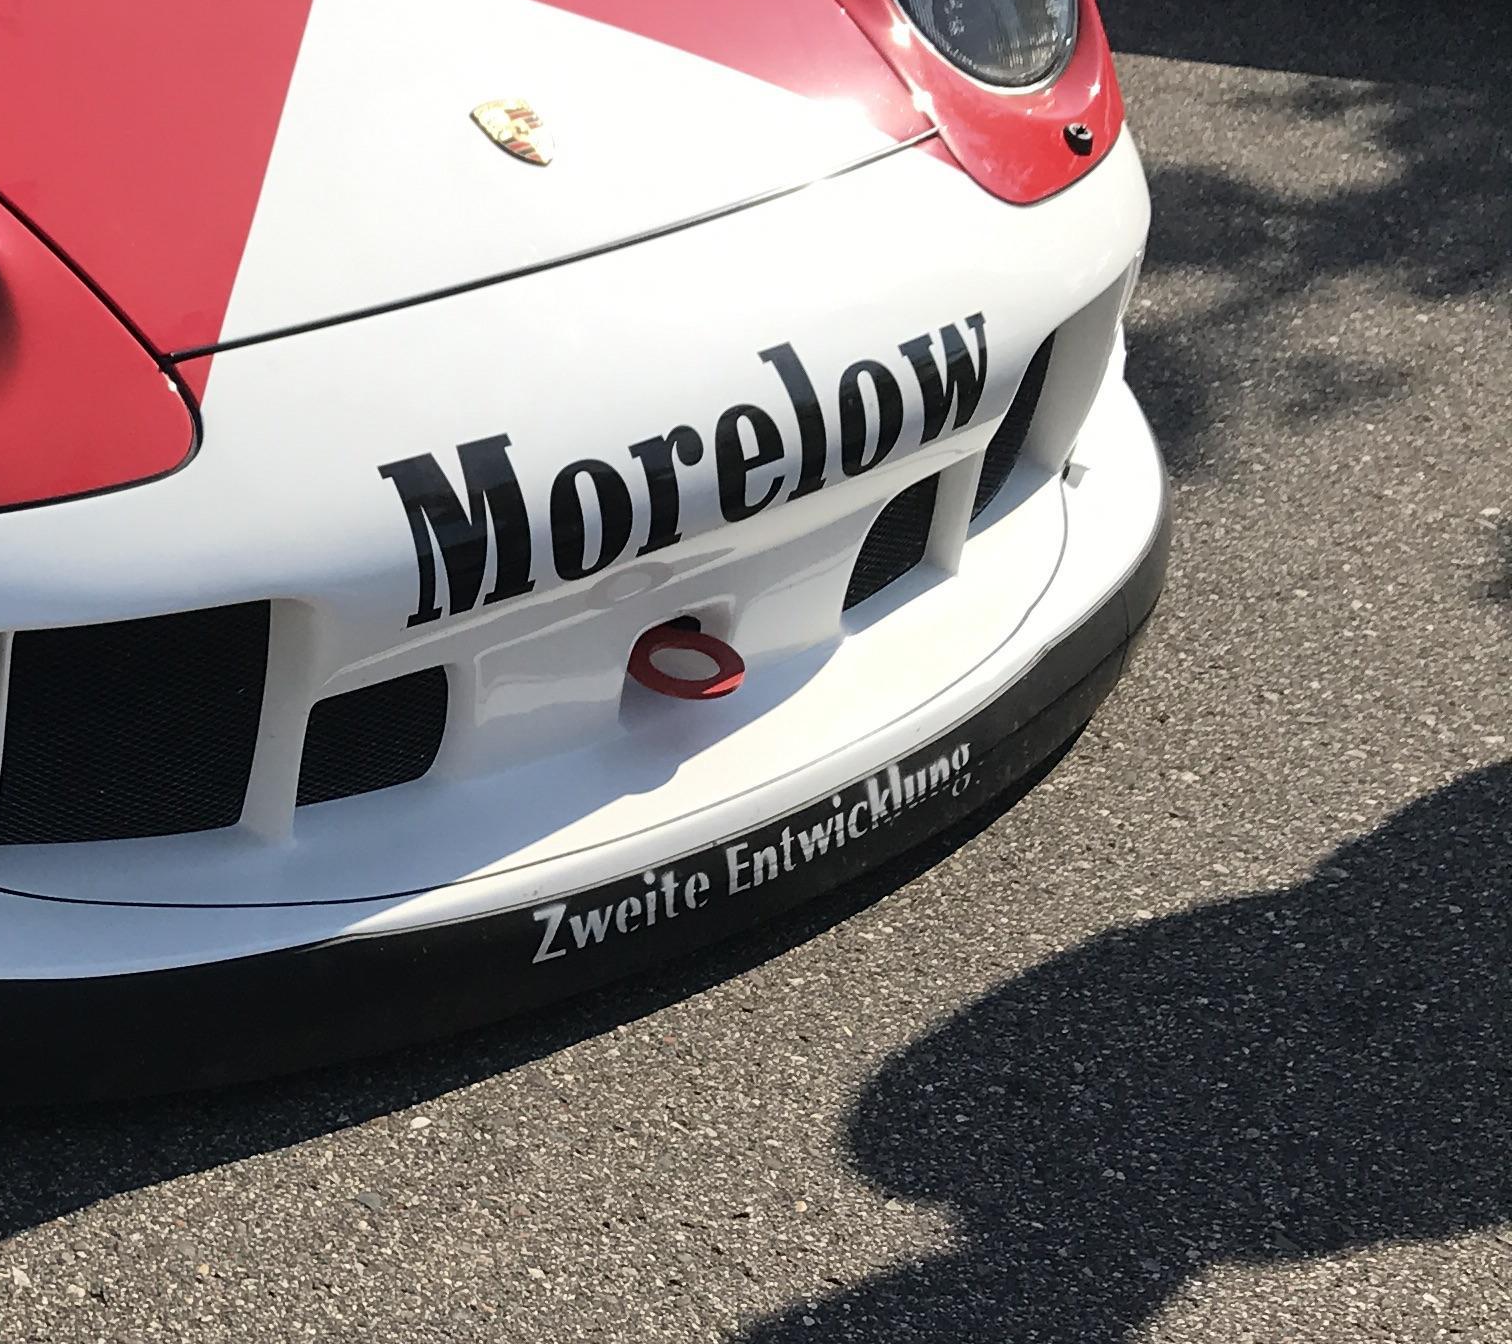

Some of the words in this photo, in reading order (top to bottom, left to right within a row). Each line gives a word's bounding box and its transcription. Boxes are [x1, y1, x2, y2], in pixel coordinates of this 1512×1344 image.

[377, 312, 987, 628] Morelow
[531, 869, 711, 964] Zweite
[724, 742, 972, 897] Entwicklung
